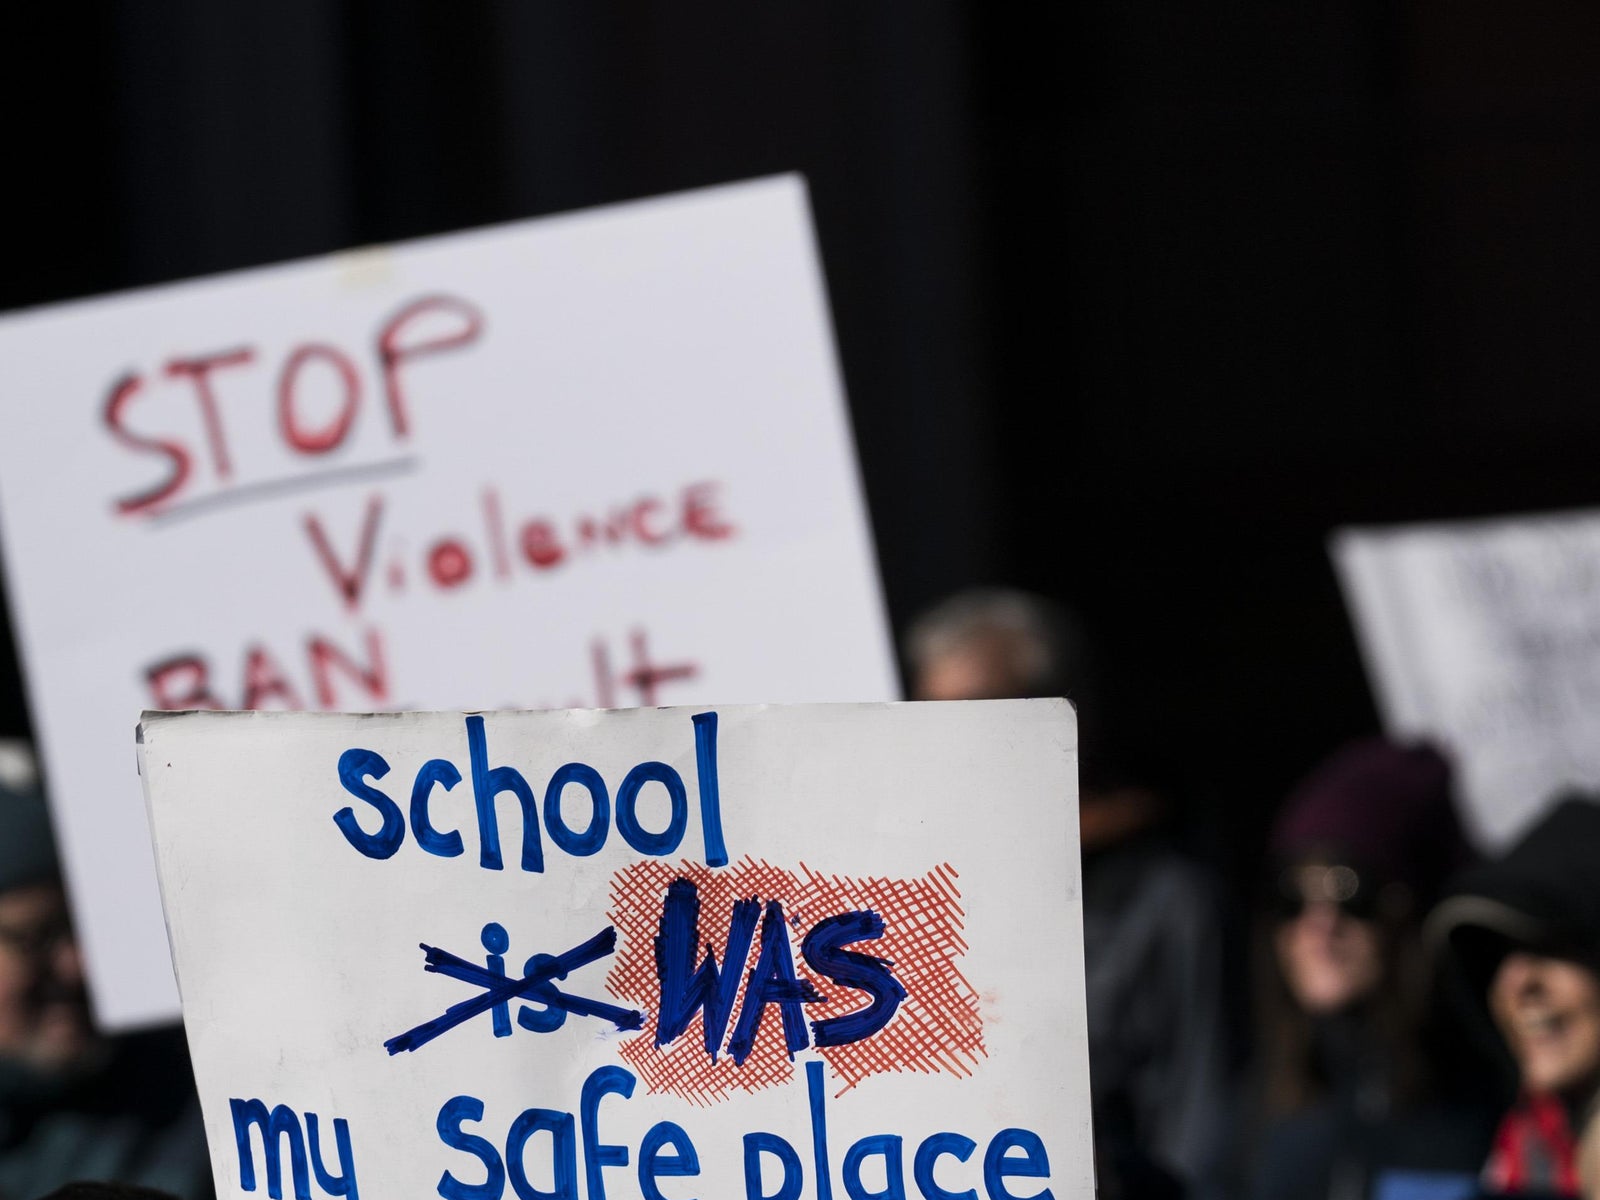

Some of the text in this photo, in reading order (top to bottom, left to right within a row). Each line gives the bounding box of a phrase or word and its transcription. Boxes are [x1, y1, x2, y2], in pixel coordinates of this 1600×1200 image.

[103, 294, 484, 516] STOP
[146, 625, 390, 709] BAN
[333, 711, 728, 873] school
[653, 876, 907, 1066] WAS
